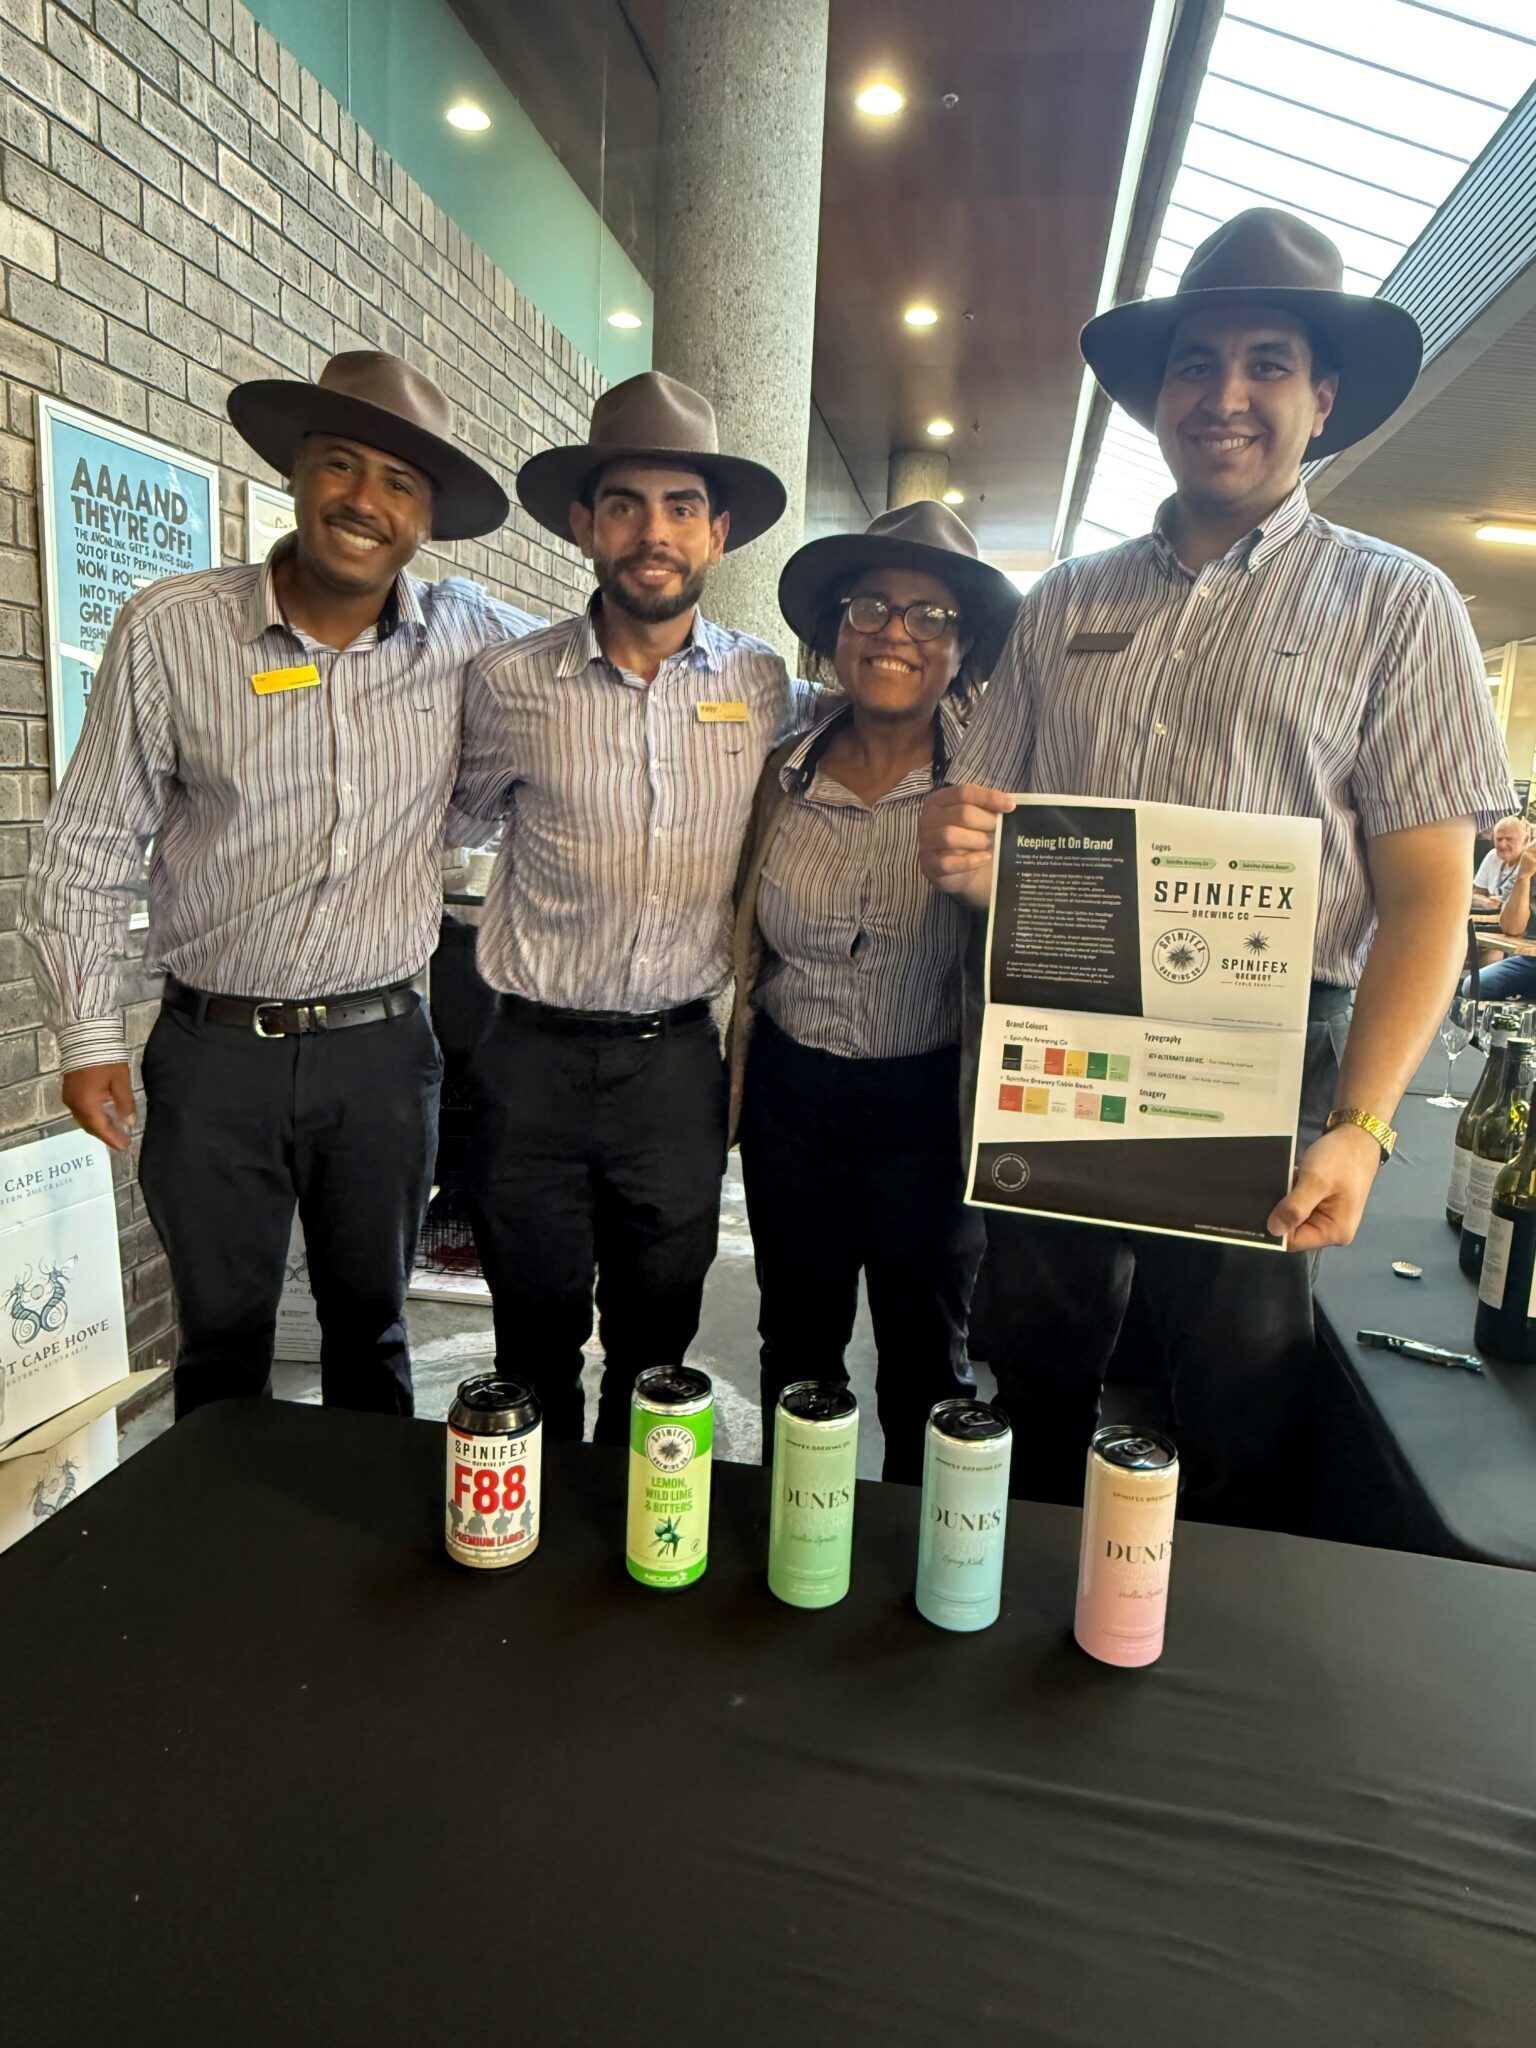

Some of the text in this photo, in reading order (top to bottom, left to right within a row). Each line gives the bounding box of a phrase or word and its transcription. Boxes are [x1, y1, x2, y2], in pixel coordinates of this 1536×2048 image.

[71, 457, 188, 525] AAAAND
[71, 495, 192, 558] THEY'RE OFF!
[74, 526, 89, 541] THE
[76, 542, 95, 557] OUT
[95, 549, 108, 560] OF
[111, 551, 131, 567] EAST
[133, 556, 158, 575] PERTH
[77, 559, 107, 581] NOW
[79, 583, 127, 605] INTO THE
[1017, 835, 1113, 851] Keeping It On Brand
[1151, 843, 1171, 852] Logos
[1154, 880, 1294, 909] SPINIFEX
[1192, 909, 1249, 920] BREWING CO
[1158, 932, 1206, 953] SPINIFEX
[1221, 958, 1288, 974] SPINIFEX
[1006, 1020, 1048, 1031] Brand Colours
[1144, 1032, 1182, 1045] Typography
[1139, 1088, 1166, 1100] Imagery
[4, 1154, 95, 1193] CAPE HOWE
[22, 1341, 60, 1368] CAPE
[65, 1319, 109, 1349] HOWE
[455, 1440, 527, 1460] SPINIFEX
[454, 1462, 526, 1515] F88
[645, 1487, 693, 1501] WILD LIME
[783, 1486, 850, 1510] DUNES
[645, 1501, 693, 1514] & BITTERS
[931, 1503, 1002, 1532] DUNES
[1106, 1540, 1172, 1564] DUNE
